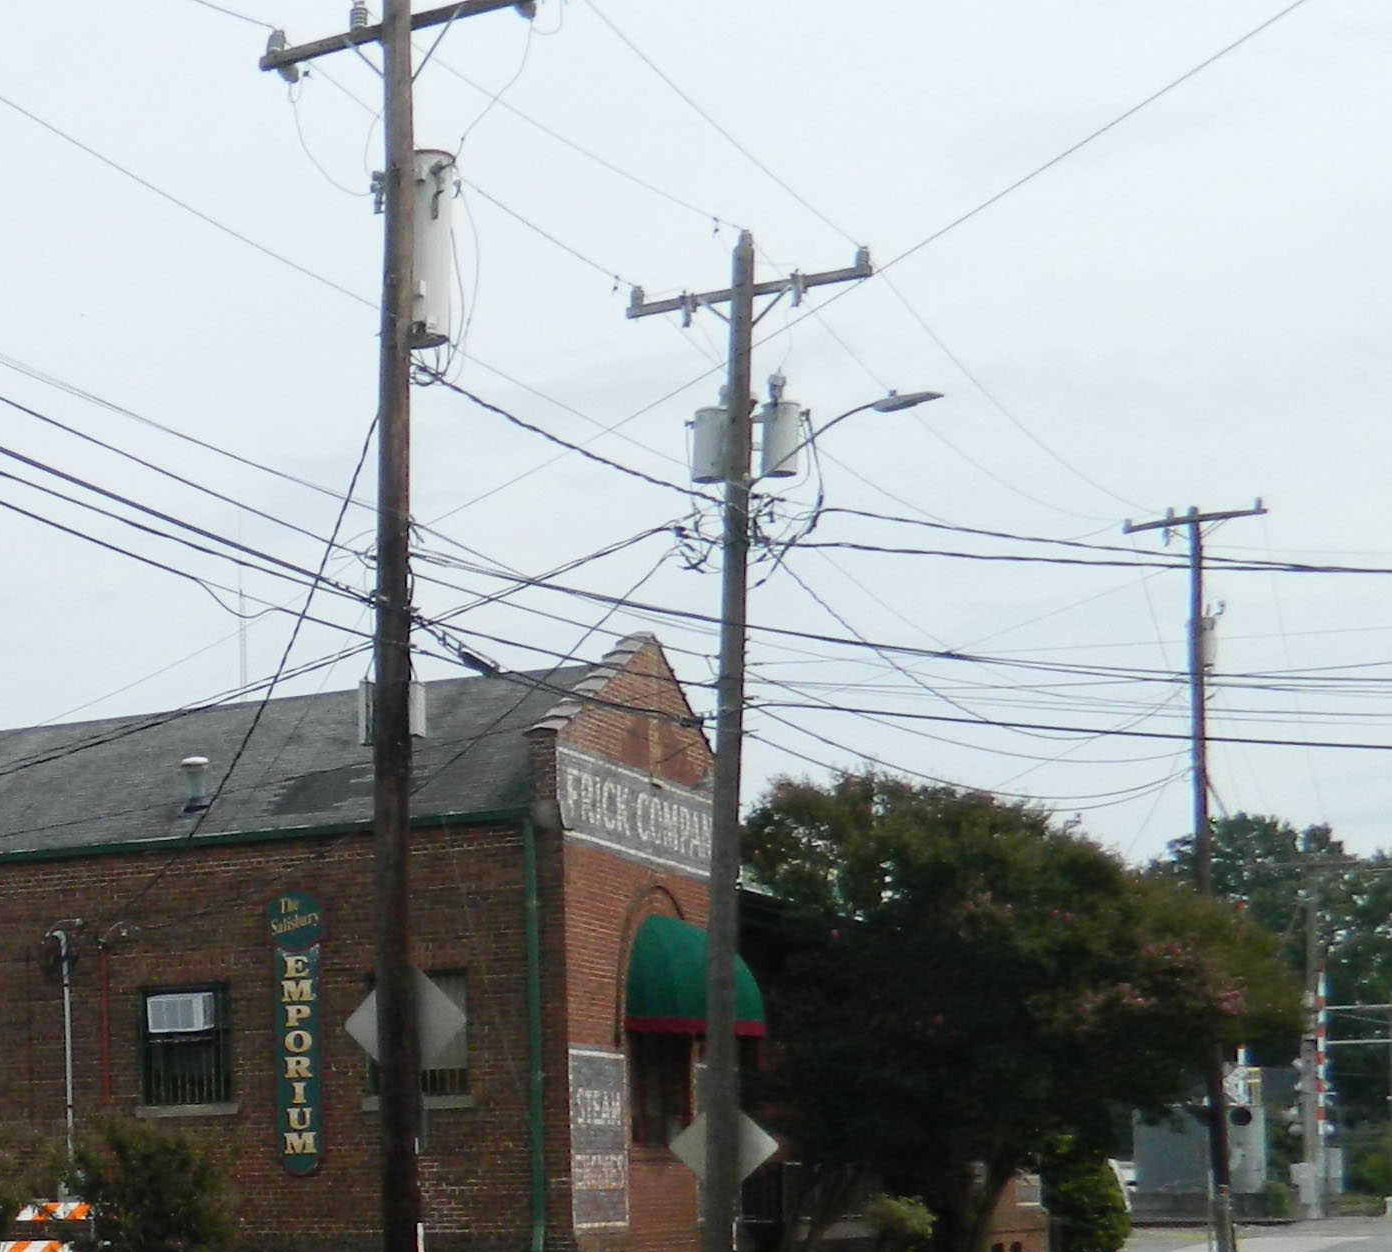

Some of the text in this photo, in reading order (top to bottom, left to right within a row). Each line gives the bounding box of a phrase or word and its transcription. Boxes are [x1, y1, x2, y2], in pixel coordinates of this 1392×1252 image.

[567, 767, 713, 858] FRICK COMPAN
[281, 955, 316, 1154] EMPORIUM
